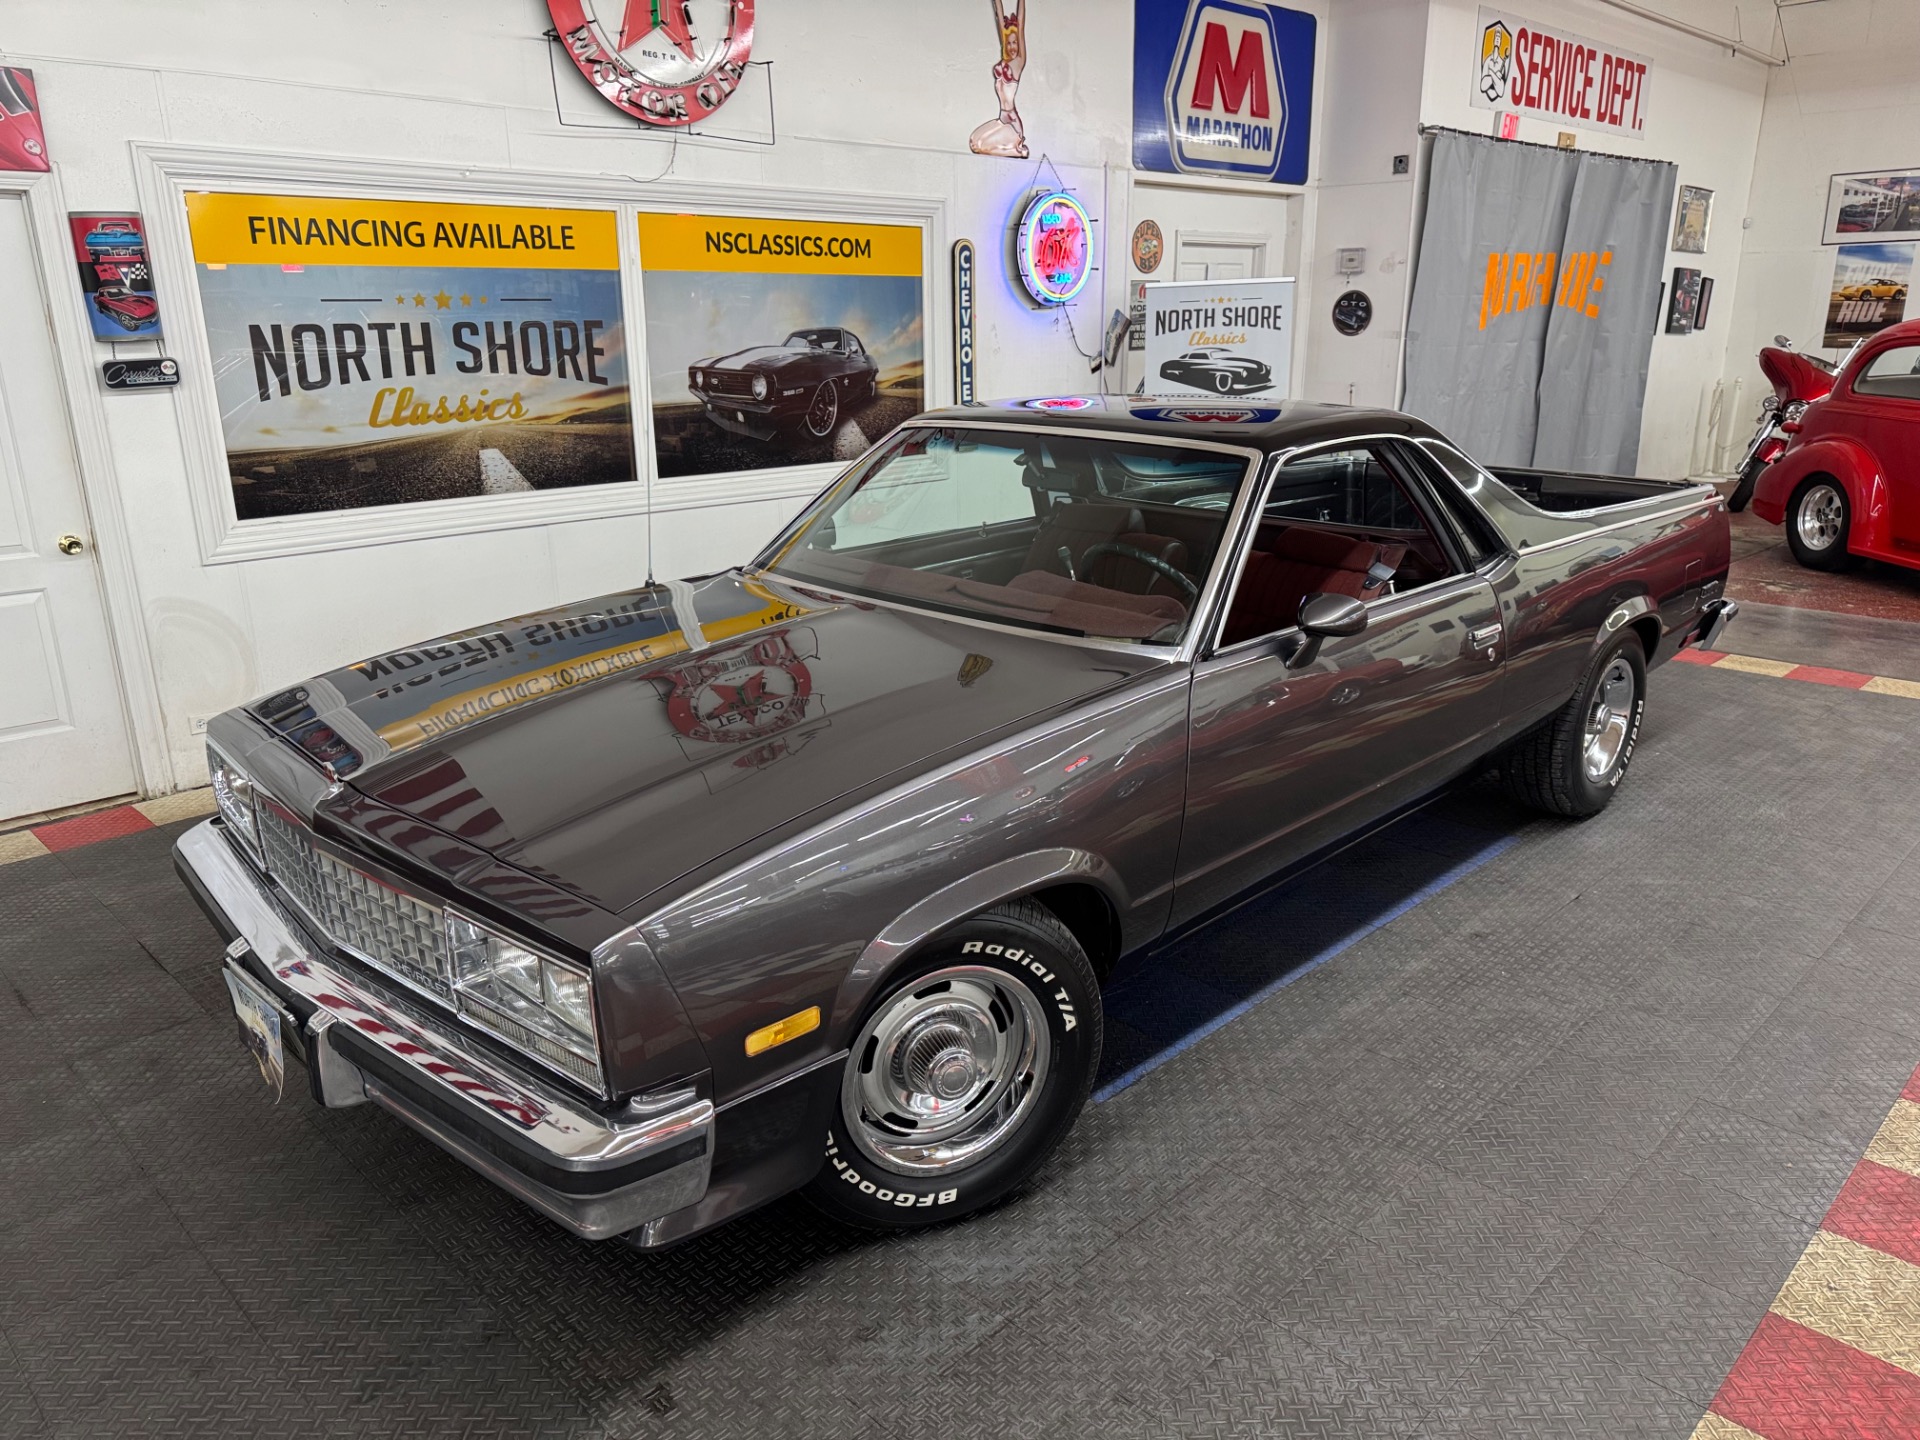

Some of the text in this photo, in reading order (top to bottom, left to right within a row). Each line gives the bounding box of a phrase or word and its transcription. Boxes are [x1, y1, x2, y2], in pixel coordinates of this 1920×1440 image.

[1191, 22, 1270, 119] M
[1511, 27, 1647, 131] SERVICE DEPT.
[1186, 115, 1273, 152] MARATHON
[248, 216, 576, 250] FINANCING AVAILABLE
[705, 231, 872, 258] NSCLASSICS.COM
[1134, 222, 1160, 251] SUPER
[1139, 251, 1159, 270] BEE
[960, 250, 973, 401] CHEVROLE
[1155, 305, 1282, 337] NORTH SHORE
[1836, 301, 1887, 323] RIDE
[1189, 331, 1248, 347] Classics
[105, 364, 164, 384] Corvette
[248, 319, 609, 402] NORTH SHORE
[368, 386, 529, 428] Classics
[1624, 700, 1644, 764] Radial
[962, 941, 1078, 1033] Radial T/A
